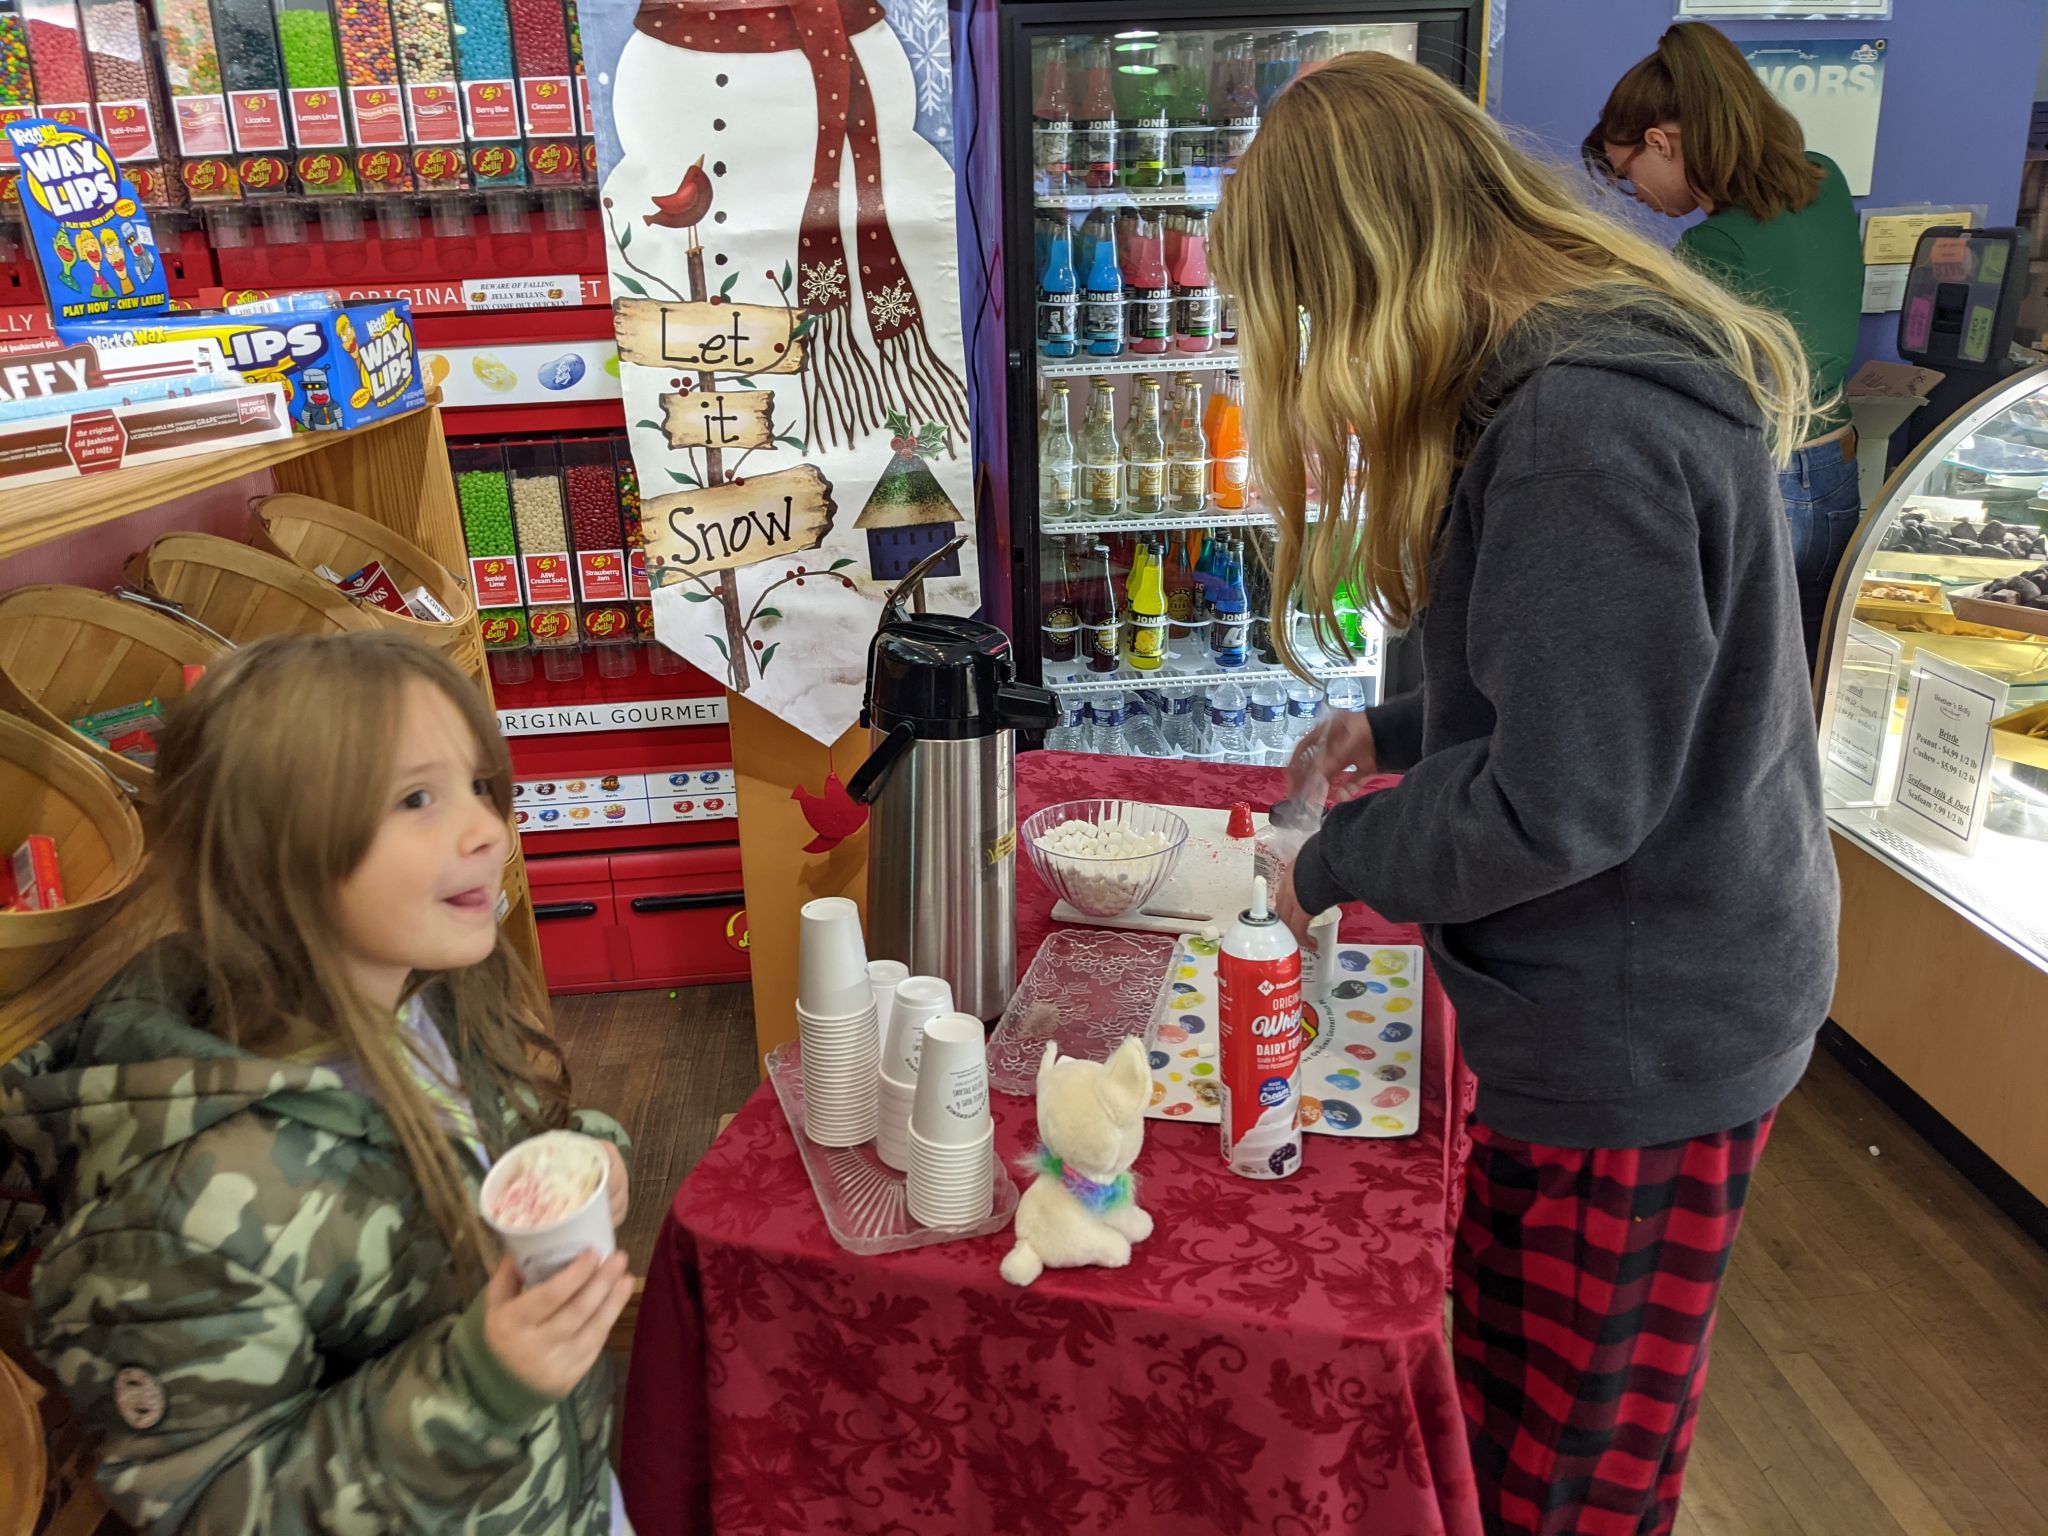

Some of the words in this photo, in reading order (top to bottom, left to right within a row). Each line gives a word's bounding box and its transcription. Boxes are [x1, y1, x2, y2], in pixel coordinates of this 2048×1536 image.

[1755, 64, 1876, 98] VORS
[476, 106, 495, 115] Berry
[495, 105, 510, 113] Blue
[244, 116, 272, 125] Licorice
[298, 114, 321, 122] Lemon
[427, 153, 447, 164] Jelly
[485, 151, 504, 162] Jelly
[541, 149, 561, 159] Jelly
[21, 140, 105, 183] WAX
[312, 159, 331, 170] Jelly
[371, 156, 391, 166] Jelly
[480, 161, 502, 172] Belly
[536, 159, 558, 169] Belly
[197, 164, 216, 175] Jelly
[252, 162, 272, 172] Jelly
[366, 165, 388, 176] Belly
[422, 164, 444, 175] Belly
[247, 172, 270, 183] Belly
[306, 169, 329, 180] Belly
[191, 175, 214, 186] Belly
[44, 173, 118, 217] LIPS
[480, 282, 510, 290] BEWARE
[511, 281, 521, 289] OF
[523, 280, 555, 289] FALLING
[515, 291, 547, 300] BELLYS,
[1049, 293, 1080, 303] JONES
[1087, 292, 1119, 301] JONES
[63, 303, 85, 318] PLAY
[87, 301, 109, 315] NOW
[117, 298, 140, 310] CHEW
[141, 292, 165, 308] LATER!
[659, 307, 754, 367] Let
[8, 341, 46, 353] fashioned
[359, 322, 408, 372] WAX
[369, 349, 412, 400] LIPS
[240, 404, 267, 416] FLAVOR
[196, 415, 218, 426] GRAPE
[699, 395, 741, 444] it
[76, 429, 88, 438] the
[89, 424, 115, 436] original
[176, 424, 197, 433] ORANGE
[87, 434, 120, 447] fashioned
[130, 431, 153, 441] LICORICE
[36, 447, 63, 457] BANANA
[81, 449, 95, 459] flat
[95, 445, 113, 456] taffy
[667, 495, 794, 567] Snow
[484, 575, 508, 583] Sunkist
[585, 569, 620, 578] Strawberry
[551, 576, 568, 584] Soda
[424, 595, 452, 622] CANDY
[541, 615, 560, 626] Jelly
[597, 612, 616, 624] Jelly
[1136, 614, 1167, 624] JONES
[1221, 611, 1250, 621] JONES
[490, 621, 509, 632] Jelly
[536, 624, 558, 635] Belly
[591, 622, 613, 632] Belly
[485, 630, 507, 641] Belly
[611, 703, 720, 724] GOURMET
[1939, 728, 1960, 744] Brittle
[1916, 733, 1937, 750] Peanut
[1942, 745, 1959, 760] $4.99
[1960, 754, 1970, 765] 1/2
[1970, 758, 1978, 770] lb
[1913, 746, 1935, 764] Cashew
[1940, 760, 1957, 775] $5.99
[1958, 769, 1968, 780] 1/2
[1969, 774, 1976, 785] lb
[1908, 773, 1932, 793] Seafoam
[1933, 787, 1946, 801] Milk
[1954, 798, 1970, 815] Dark
[1907, 788, 1932, 809] Seafoam
[1933, 803, 1946, 816] 7.99
[1946, 811, 1957, 823] 1/2
[1957, 816, 1964, 826] lb
[1256, 1041, 1286, 1056] DAIRY
[1260, 1087, 1290, 1103] Cream
